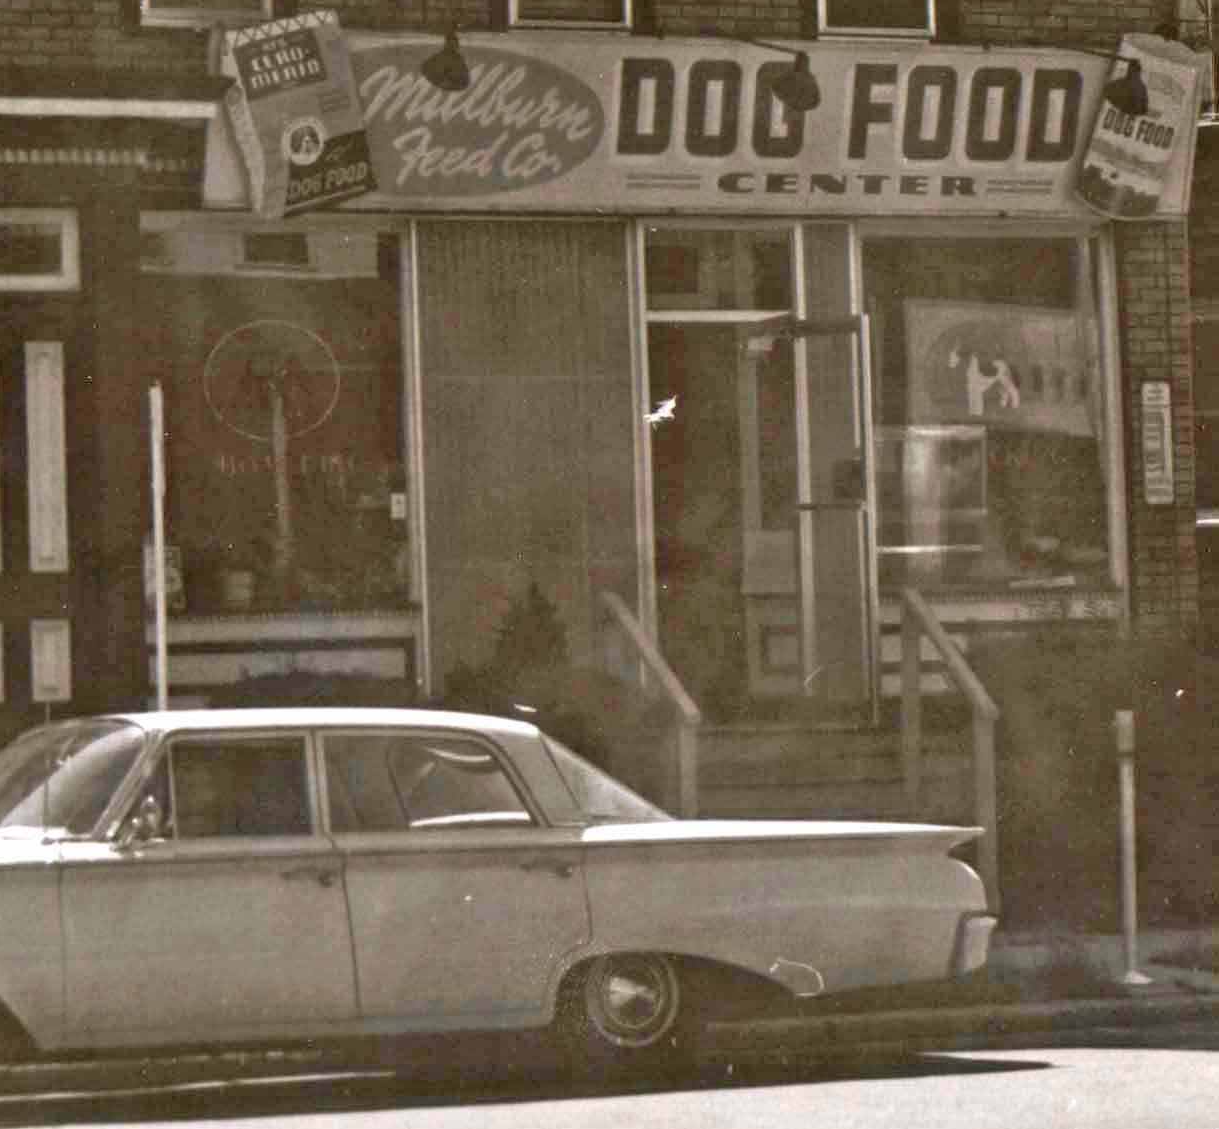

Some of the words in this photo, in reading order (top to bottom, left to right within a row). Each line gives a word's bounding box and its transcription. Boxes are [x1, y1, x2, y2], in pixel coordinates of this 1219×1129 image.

[617, 58, 810, 159] DOG
[847, 62, 1083, 161] FOOD
[1102, 108, 1135, 139] DOG
[1135, 119, 1175, 150] FOOD
[325, 160, 369, 192] FOOD
[392, 126, 510, 188] Feed
[716, 173, 977, 195] CENTER
